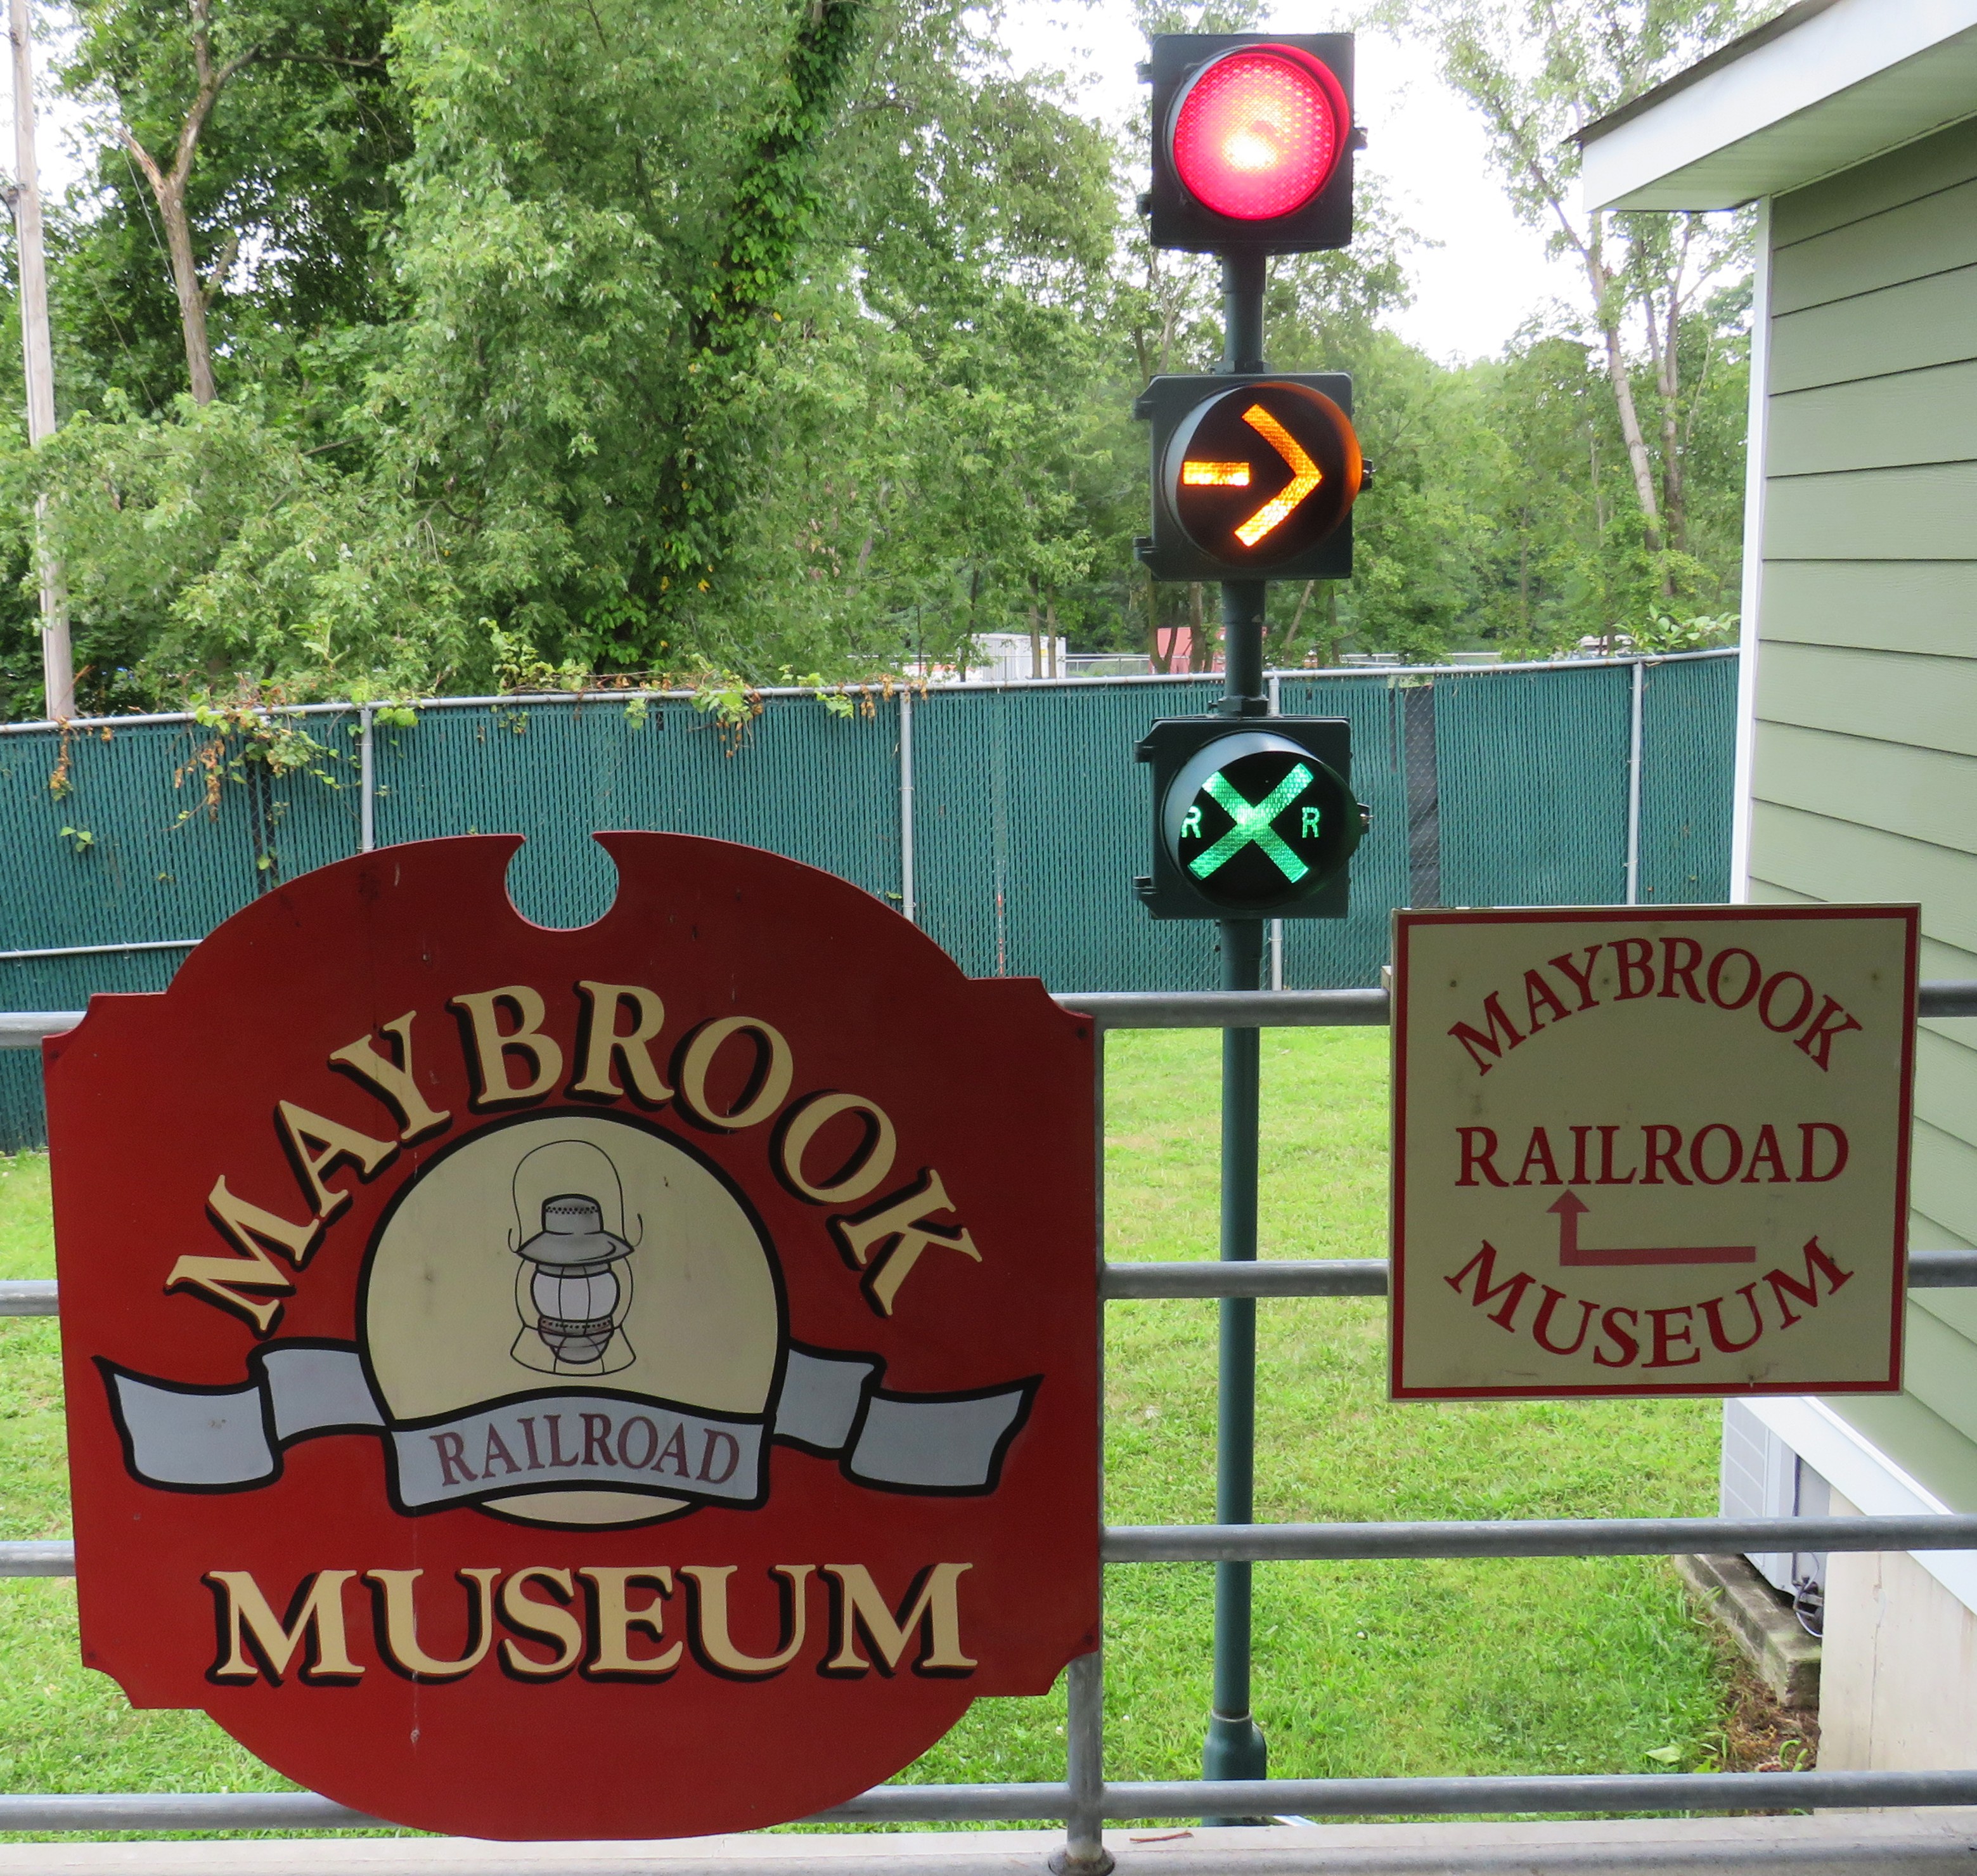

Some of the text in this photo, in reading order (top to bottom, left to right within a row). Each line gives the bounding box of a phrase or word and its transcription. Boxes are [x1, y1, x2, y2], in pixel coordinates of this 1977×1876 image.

[1301, 806, 1320, 838] R
[1447, 936, 1862, 1077] MAYBROOK
[165, 980, 982, 1334] MAYBROOK
[1455, 1122, 1850, 1187] RAILROAD
[1443, 1235, 1855, 1368] MUSEUM
[429, 1413, 740, 1487] RAILROAD
[205, 1562, 978, 1681] MUSEUM
